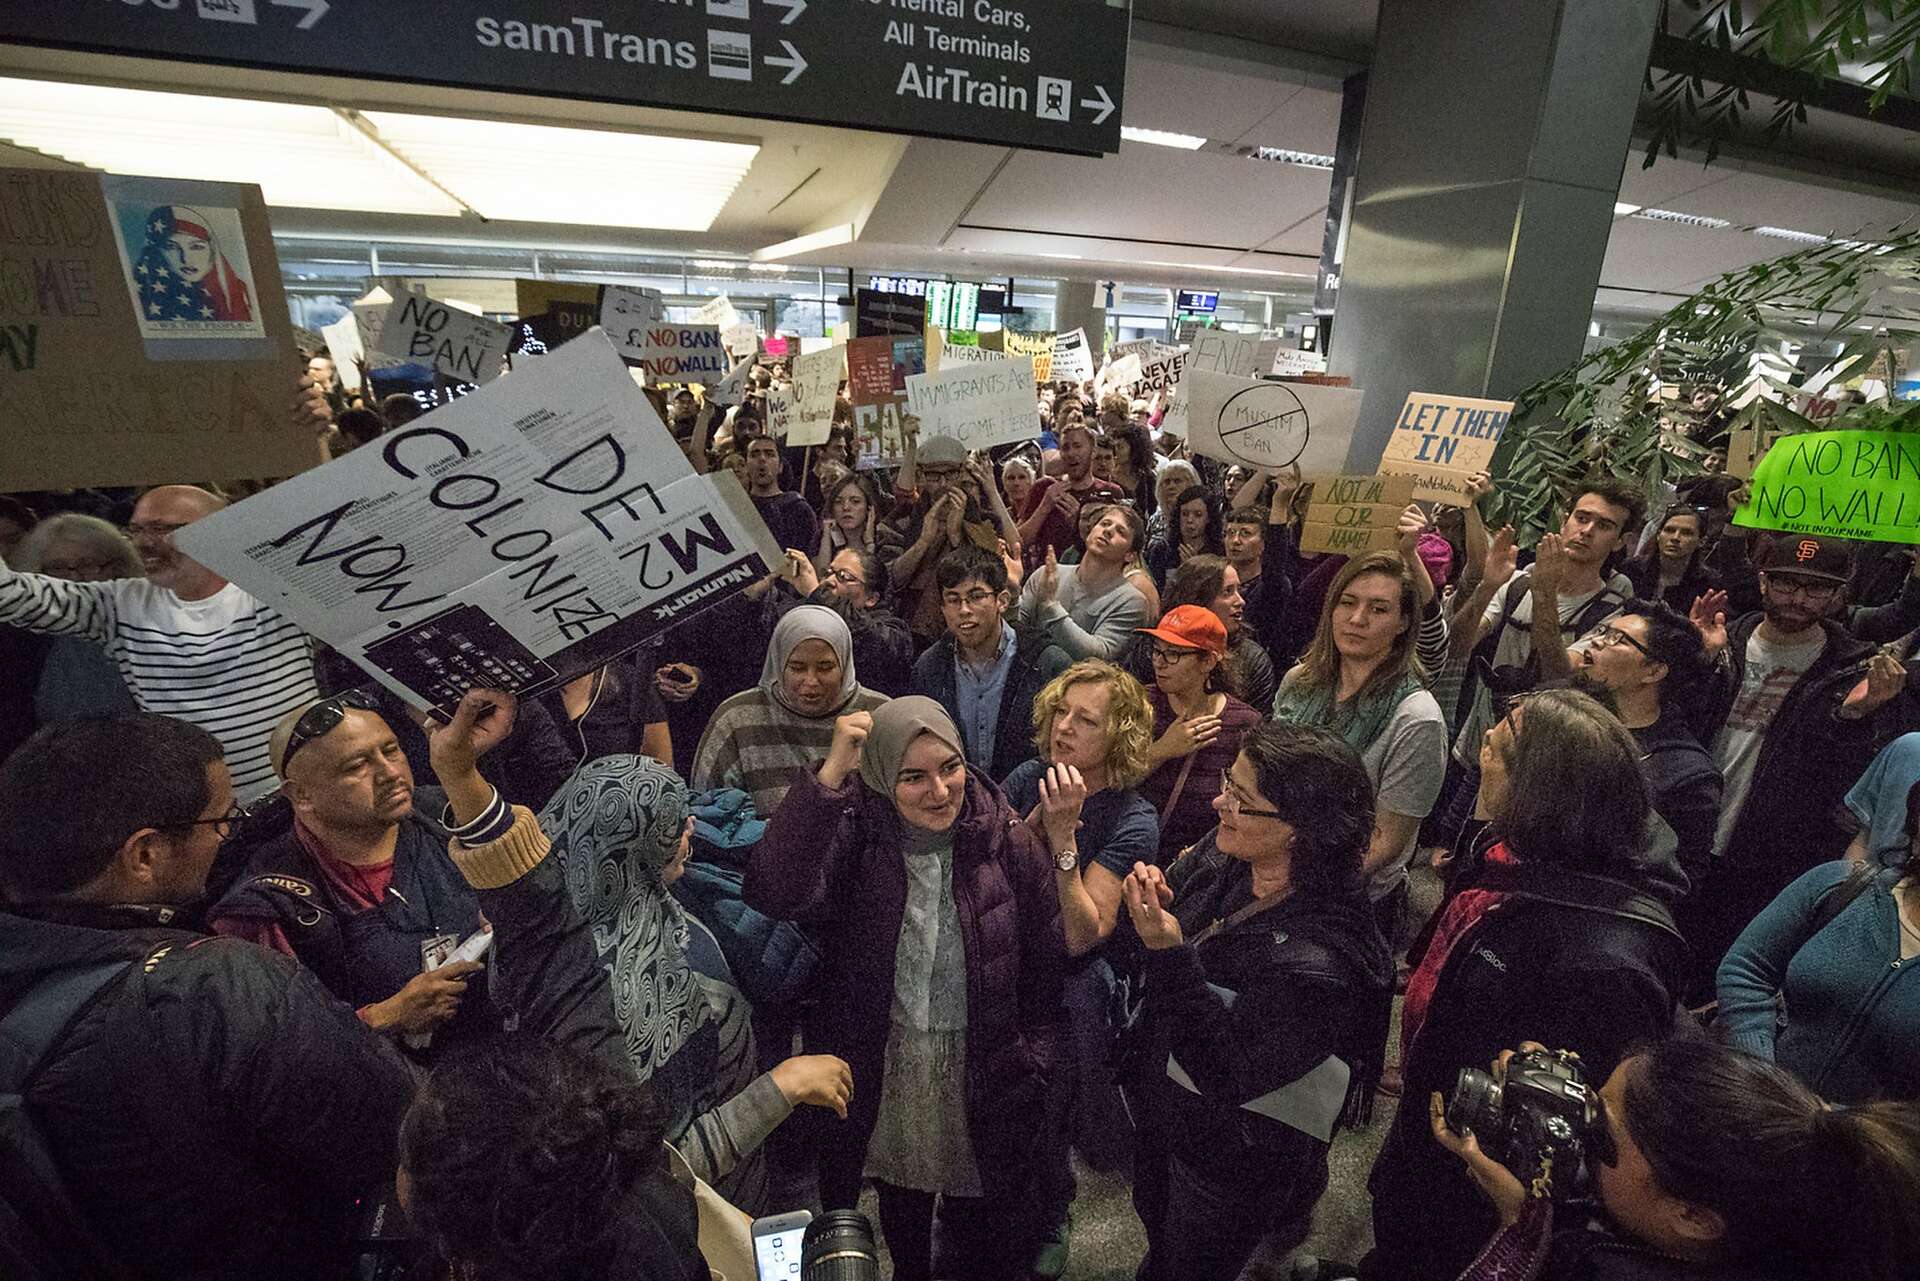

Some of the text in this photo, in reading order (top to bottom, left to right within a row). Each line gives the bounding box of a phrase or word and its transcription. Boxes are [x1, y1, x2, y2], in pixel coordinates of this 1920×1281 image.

[973, 0, 1032, 33] Cars,
[475, 16, 698, 70] samTrans
[883, 20, 1031, 63] All Terminals
[896, 61, 1028, 111] AirTrain
[399, 297, 450, 333] NO
[409, 331, 486, 379] BAN
[646, 328, 677, 348] NO
[679, 329, 720, 349] BAN
[643, 355, 723, 377] NO WALL
[911, 374, 1005, 411] IMMIGRANTS
[1236, 406, 1293, 434] MUSLIM
[1399, 402, 1451, 433] LET
[1243, 434, 1271, 455] BAN
[1414, 434, 1459, 464] IN
[1787, 439, 1920, 481] NO BAN
[534, 432, 666, 542] DE
[1326, 478, 1385, 504] NOT IN
[1756, 484, 1806, 519] NO
[383, 426, 622, 641] COLONIZE
[1334, 505, 1373, 527] OUR
[619, 510, 736, 591] M2
[1326, 530, 1372, 550] NAME!
[652, 562, 754, 621] Numark
